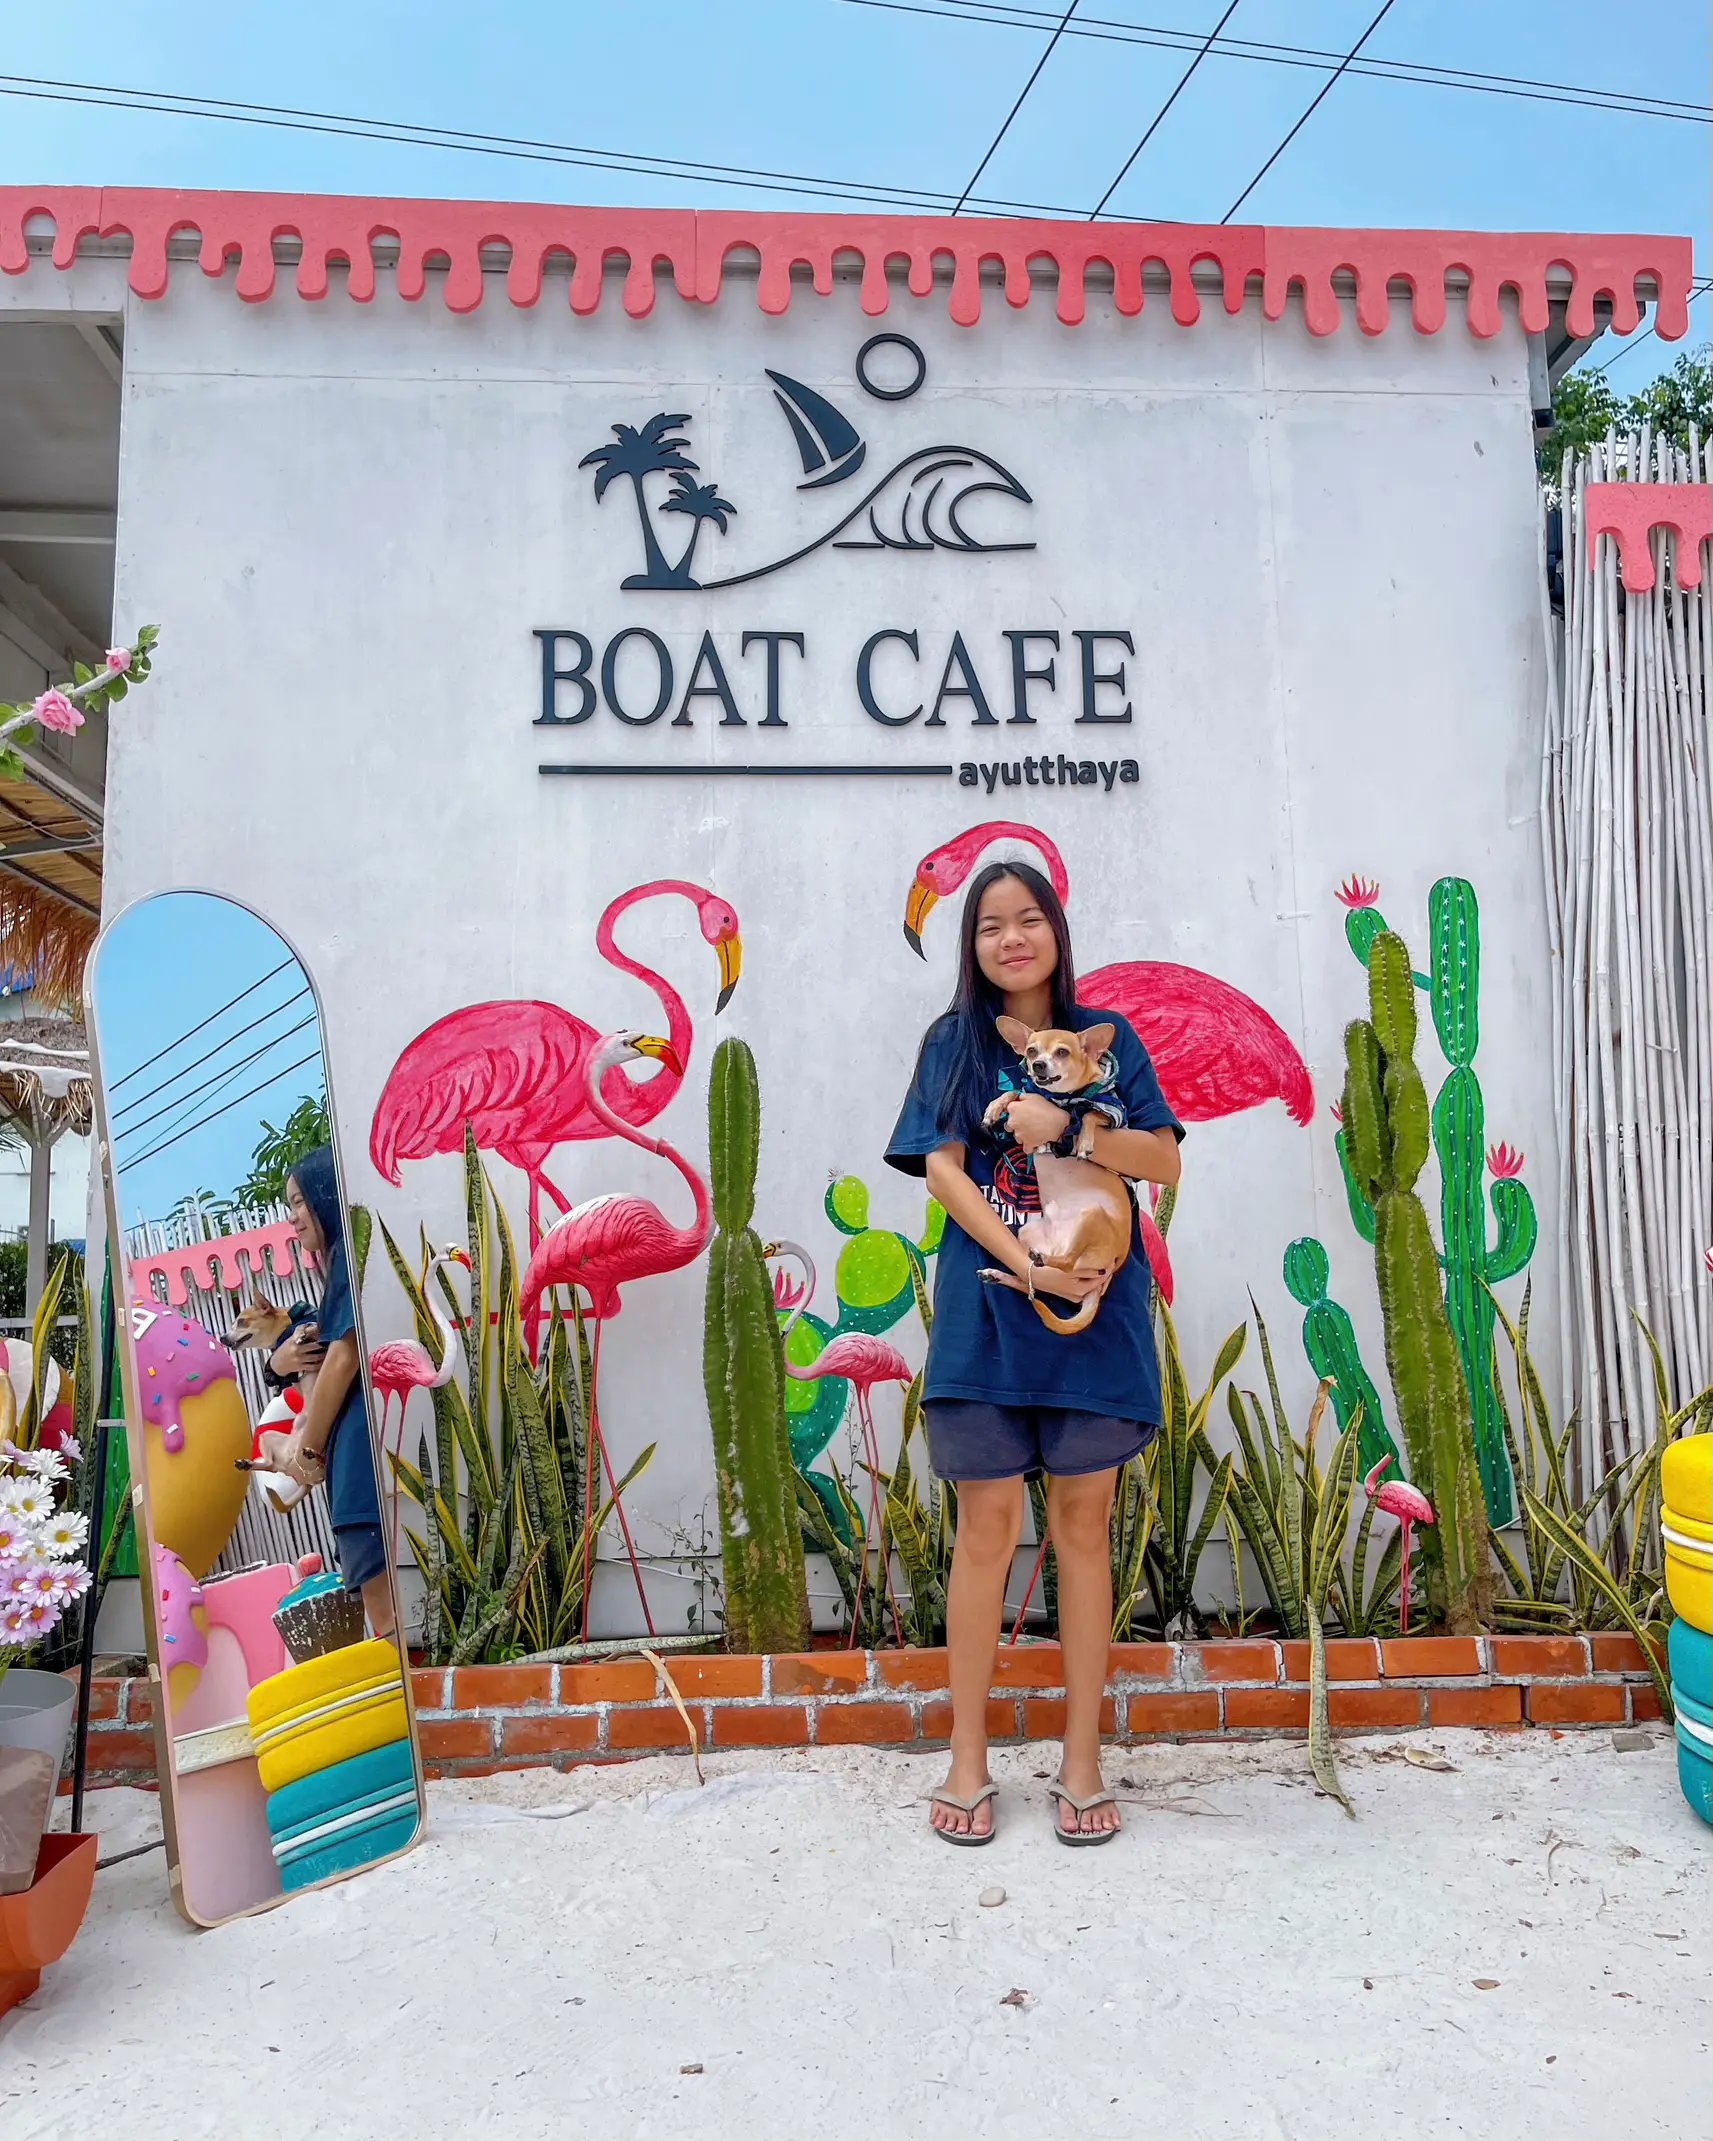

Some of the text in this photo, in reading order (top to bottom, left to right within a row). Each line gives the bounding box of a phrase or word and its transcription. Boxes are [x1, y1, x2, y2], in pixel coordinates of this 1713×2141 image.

[532, 627, 1136, 727] BOAT CAFE
[959, 754, 1140, 794] ayutthaya
